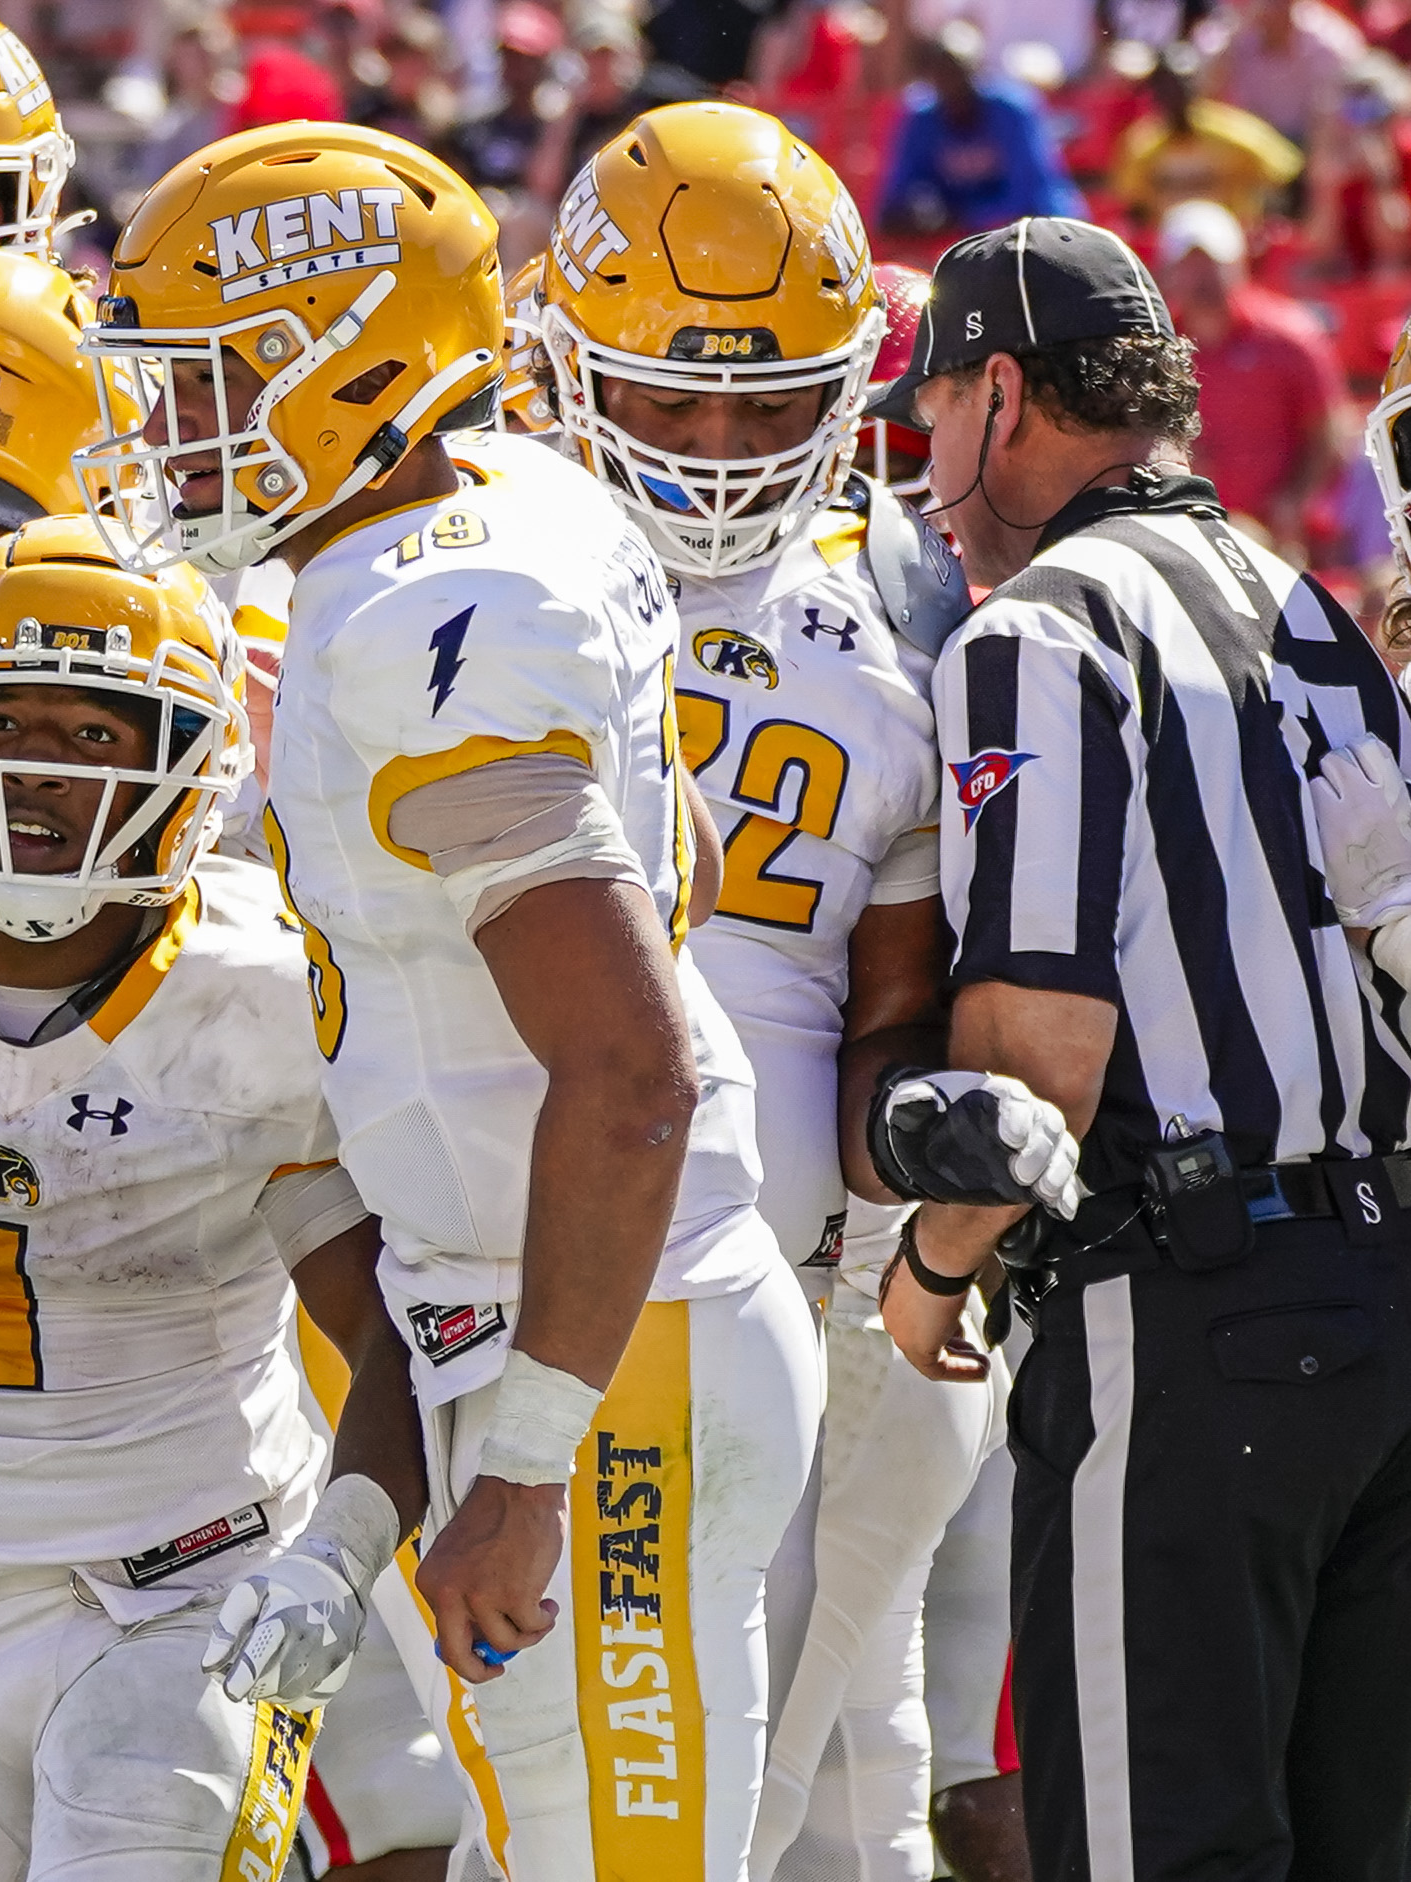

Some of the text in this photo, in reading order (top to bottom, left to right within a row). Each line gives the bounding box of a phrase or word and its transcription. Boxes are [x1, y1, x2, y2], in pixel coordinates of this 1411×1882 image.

[207, 188, 404, 280] KENT
[259, 251, 364, 287] STATE
[702, 334, 753, 356] 304
[384, 508, 491, 568] 19
[52, 631, 90, 649] 301
[970, 771, 996, 798] CFO
[180, 1520, 227, 1550] AUTHENTIC
